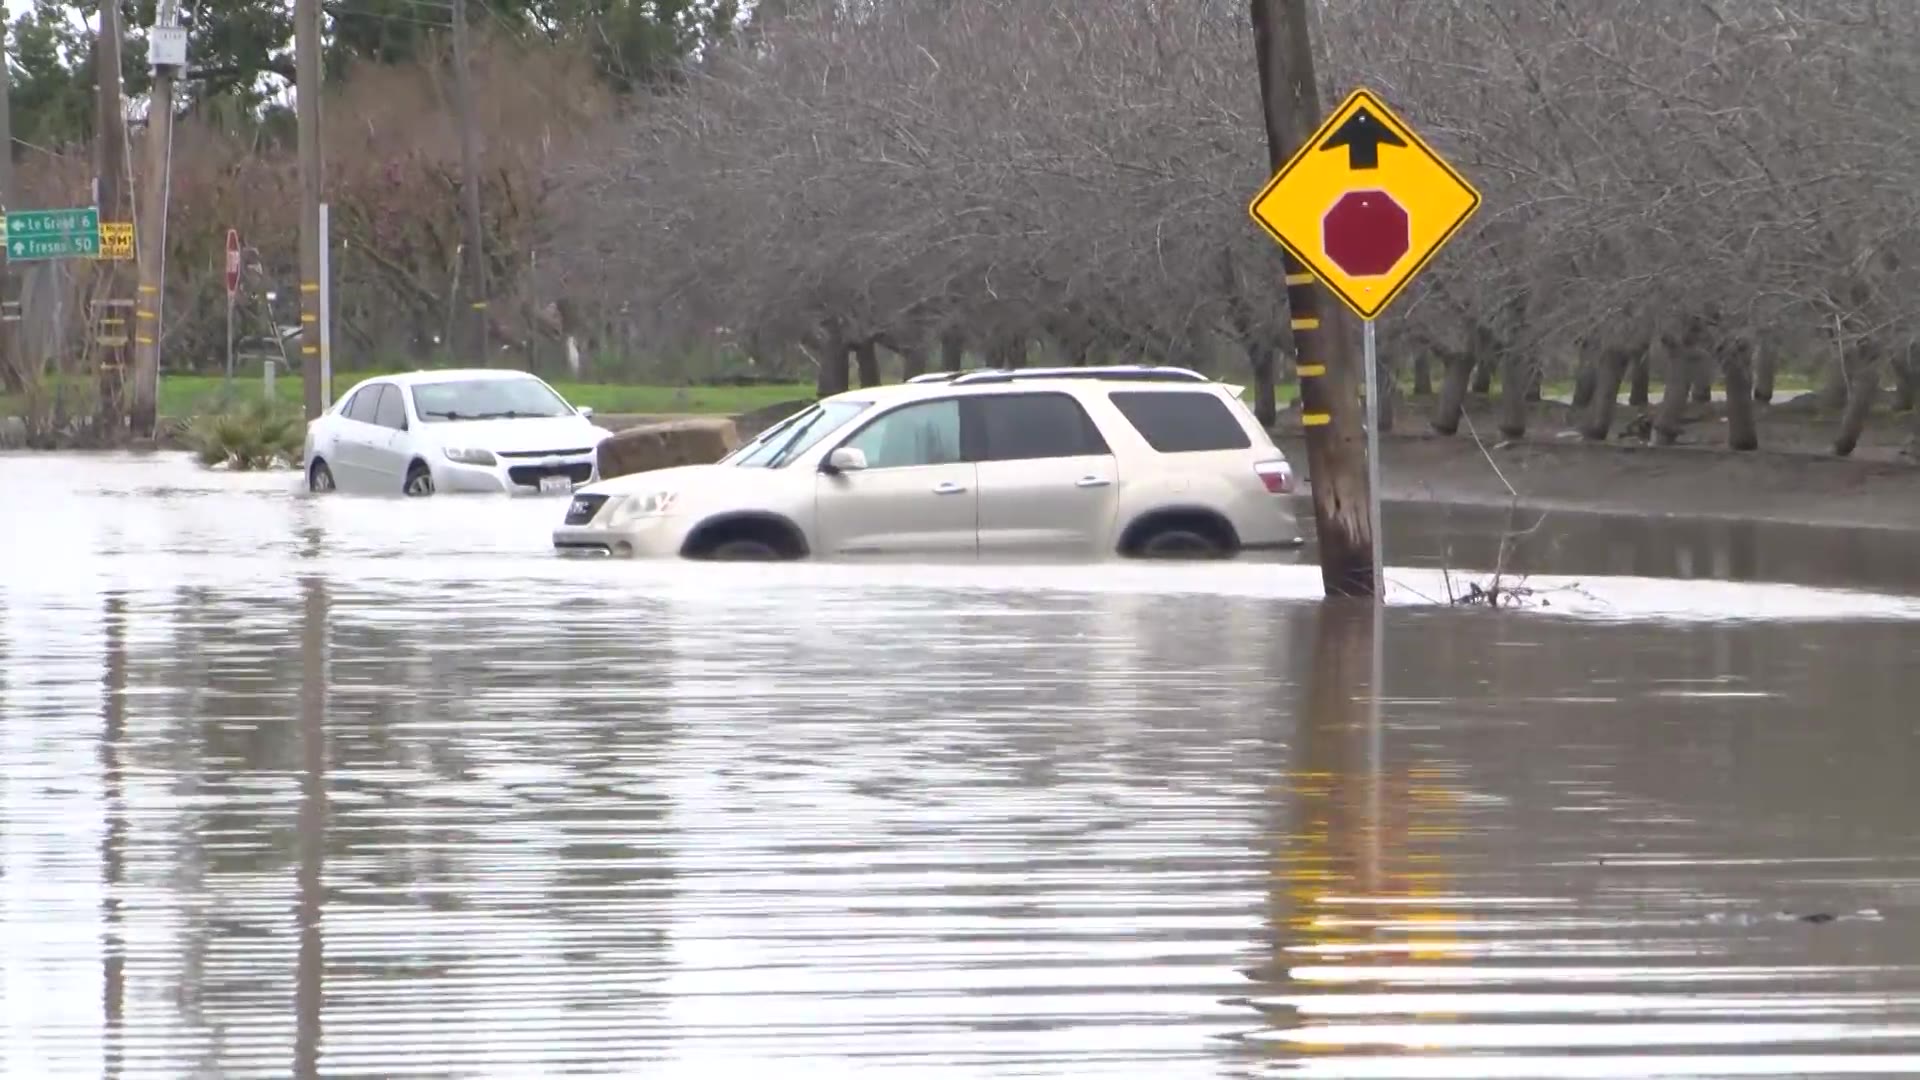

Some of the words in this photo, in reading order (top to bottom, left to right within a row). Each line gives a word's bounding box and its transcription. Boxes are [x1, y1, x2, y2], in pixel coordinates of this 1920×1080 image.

[27, 217, 41, 230] Le
[82, 215, 91, 228] 6
[75, 237, 92, 251] 50
